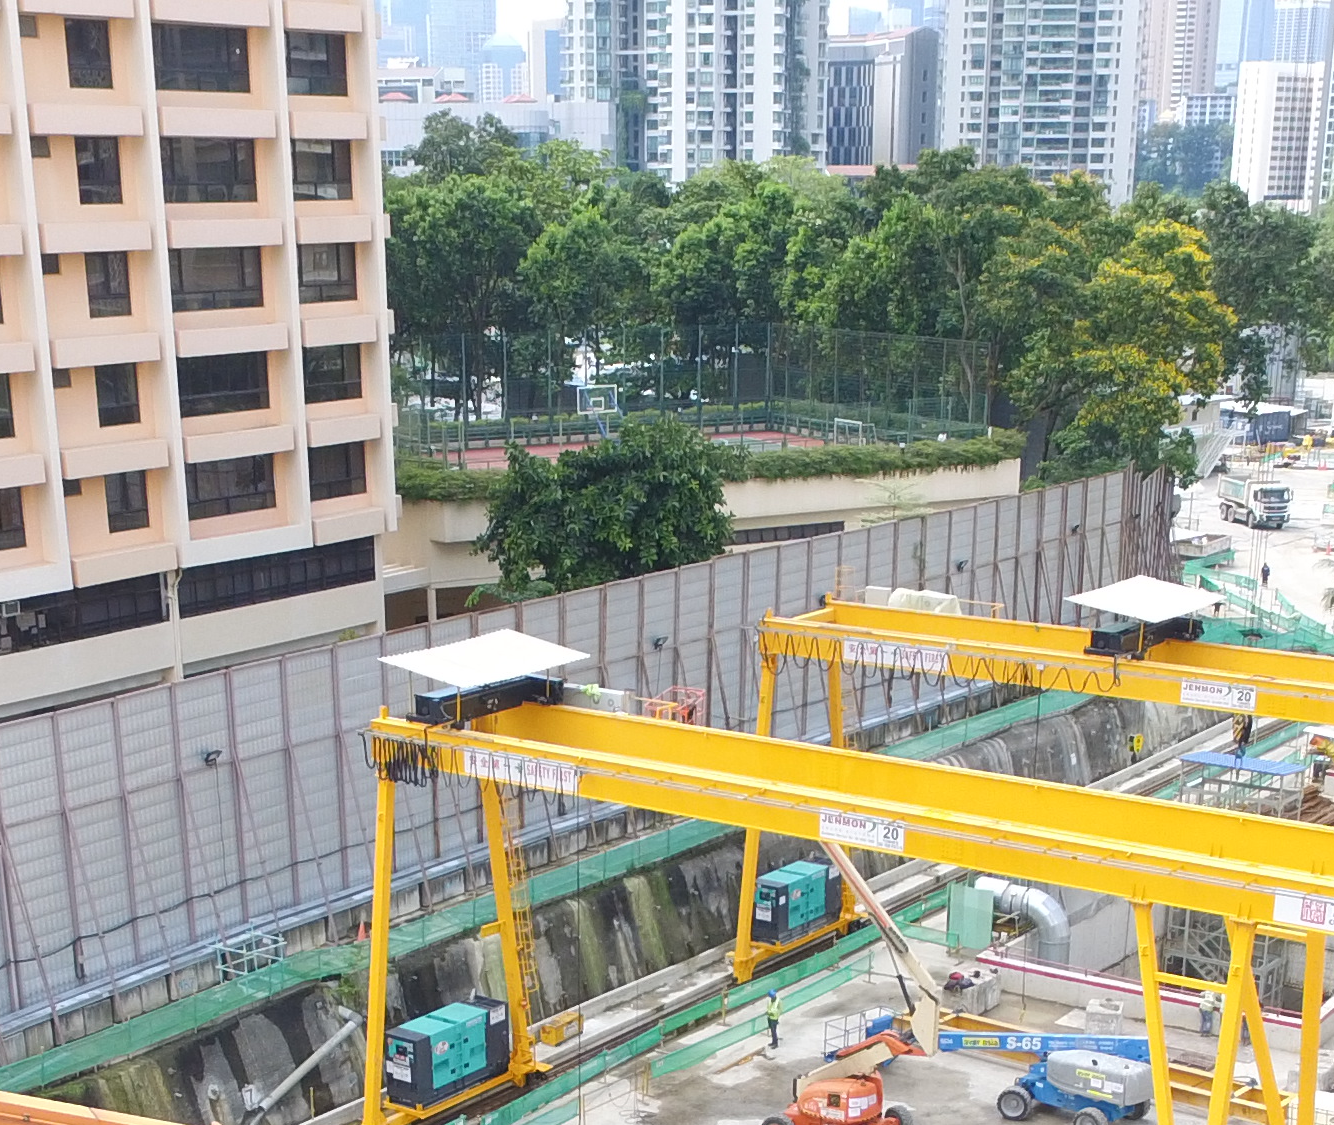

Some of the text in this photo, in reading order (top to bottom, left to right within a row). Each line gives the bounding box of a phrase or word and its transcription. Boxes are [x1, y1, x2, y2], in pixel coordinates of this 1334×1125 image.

[1183, 683, 1223, 694] JENMON
[1237, 691, 1252, 702] 20
[822, 812, 867, 829] JENMON
[883, 826, 899, 840] 20
[1006, 1036, 1042, 1050] S-65
